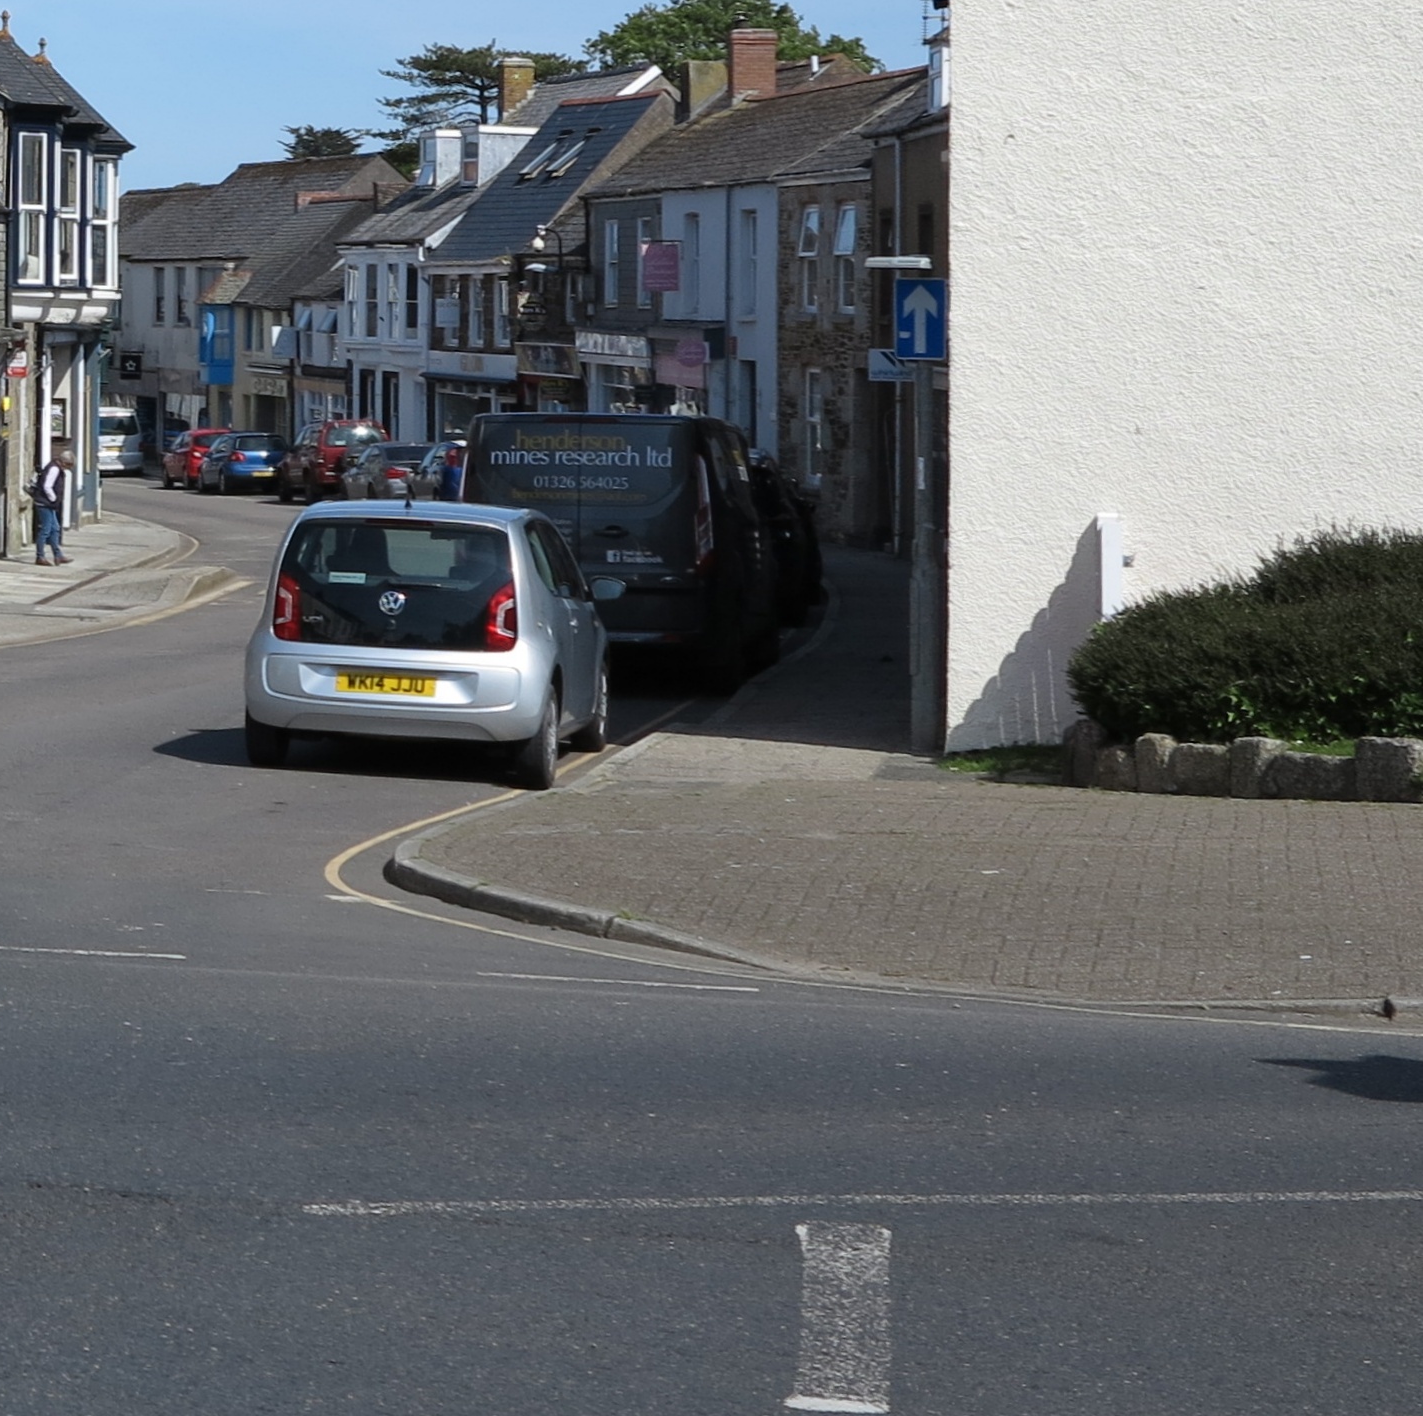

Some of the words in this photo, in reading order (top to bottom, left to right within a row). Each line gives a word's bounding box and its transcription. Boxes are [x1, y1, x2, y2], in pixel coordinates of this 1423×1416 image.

[515, 429, 625, 450] henderson
[490, 445, 549, 465] mines
[554, 446, 640, 467] research
[646, 446, 673, 468] ltd
[533, 475, 576, 489] 01326
[579, 476, 629, 490] 564025
[347, 674, 386, 689] WK14
[391, 677, 426, 693] JJU
